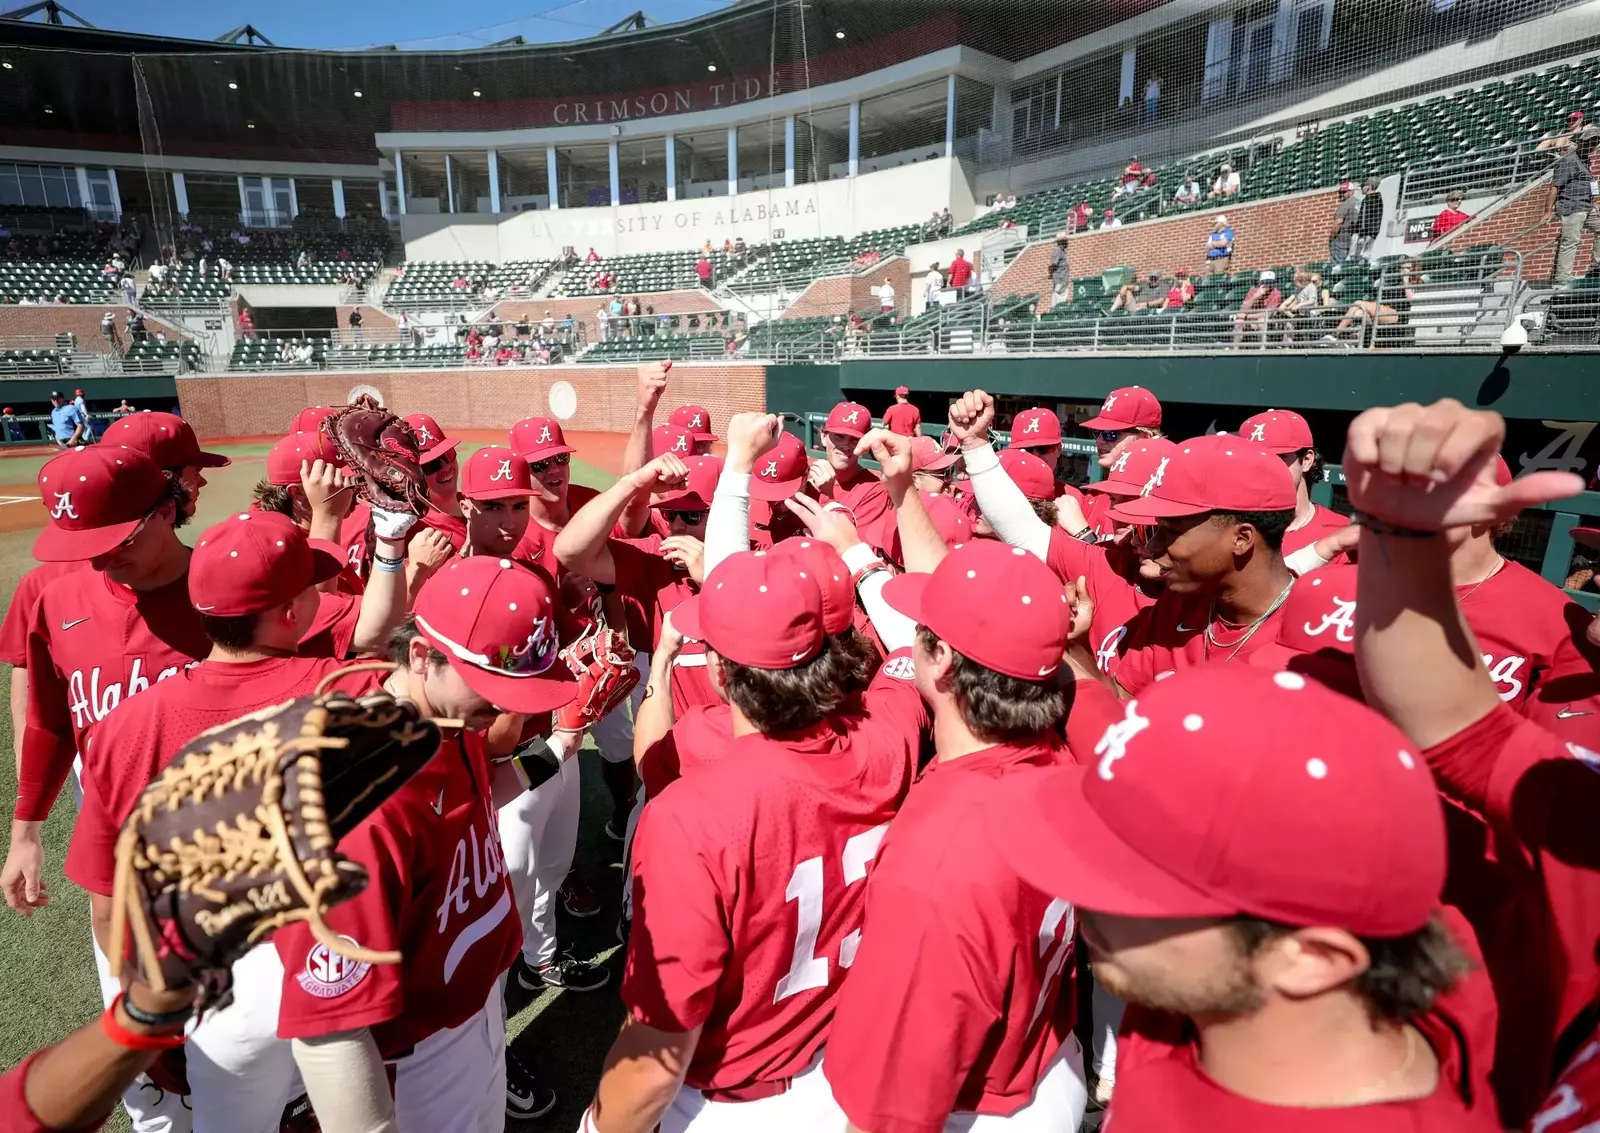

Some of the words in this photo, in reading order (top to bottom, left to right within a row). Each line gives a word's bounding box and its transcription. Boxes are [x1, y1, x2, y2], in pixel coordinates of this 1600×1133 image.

[553, 88, 692, 124] CRIMSON
[709, 71, 781, 106] TIDE
[674, 211, 701, 228] OF
[714, 198, 816, 225] ALABAMA
[490, 459, 513, 481] A
[51, 492, 79, 519] A
[305, 973, 361, 998] GRADUATE
